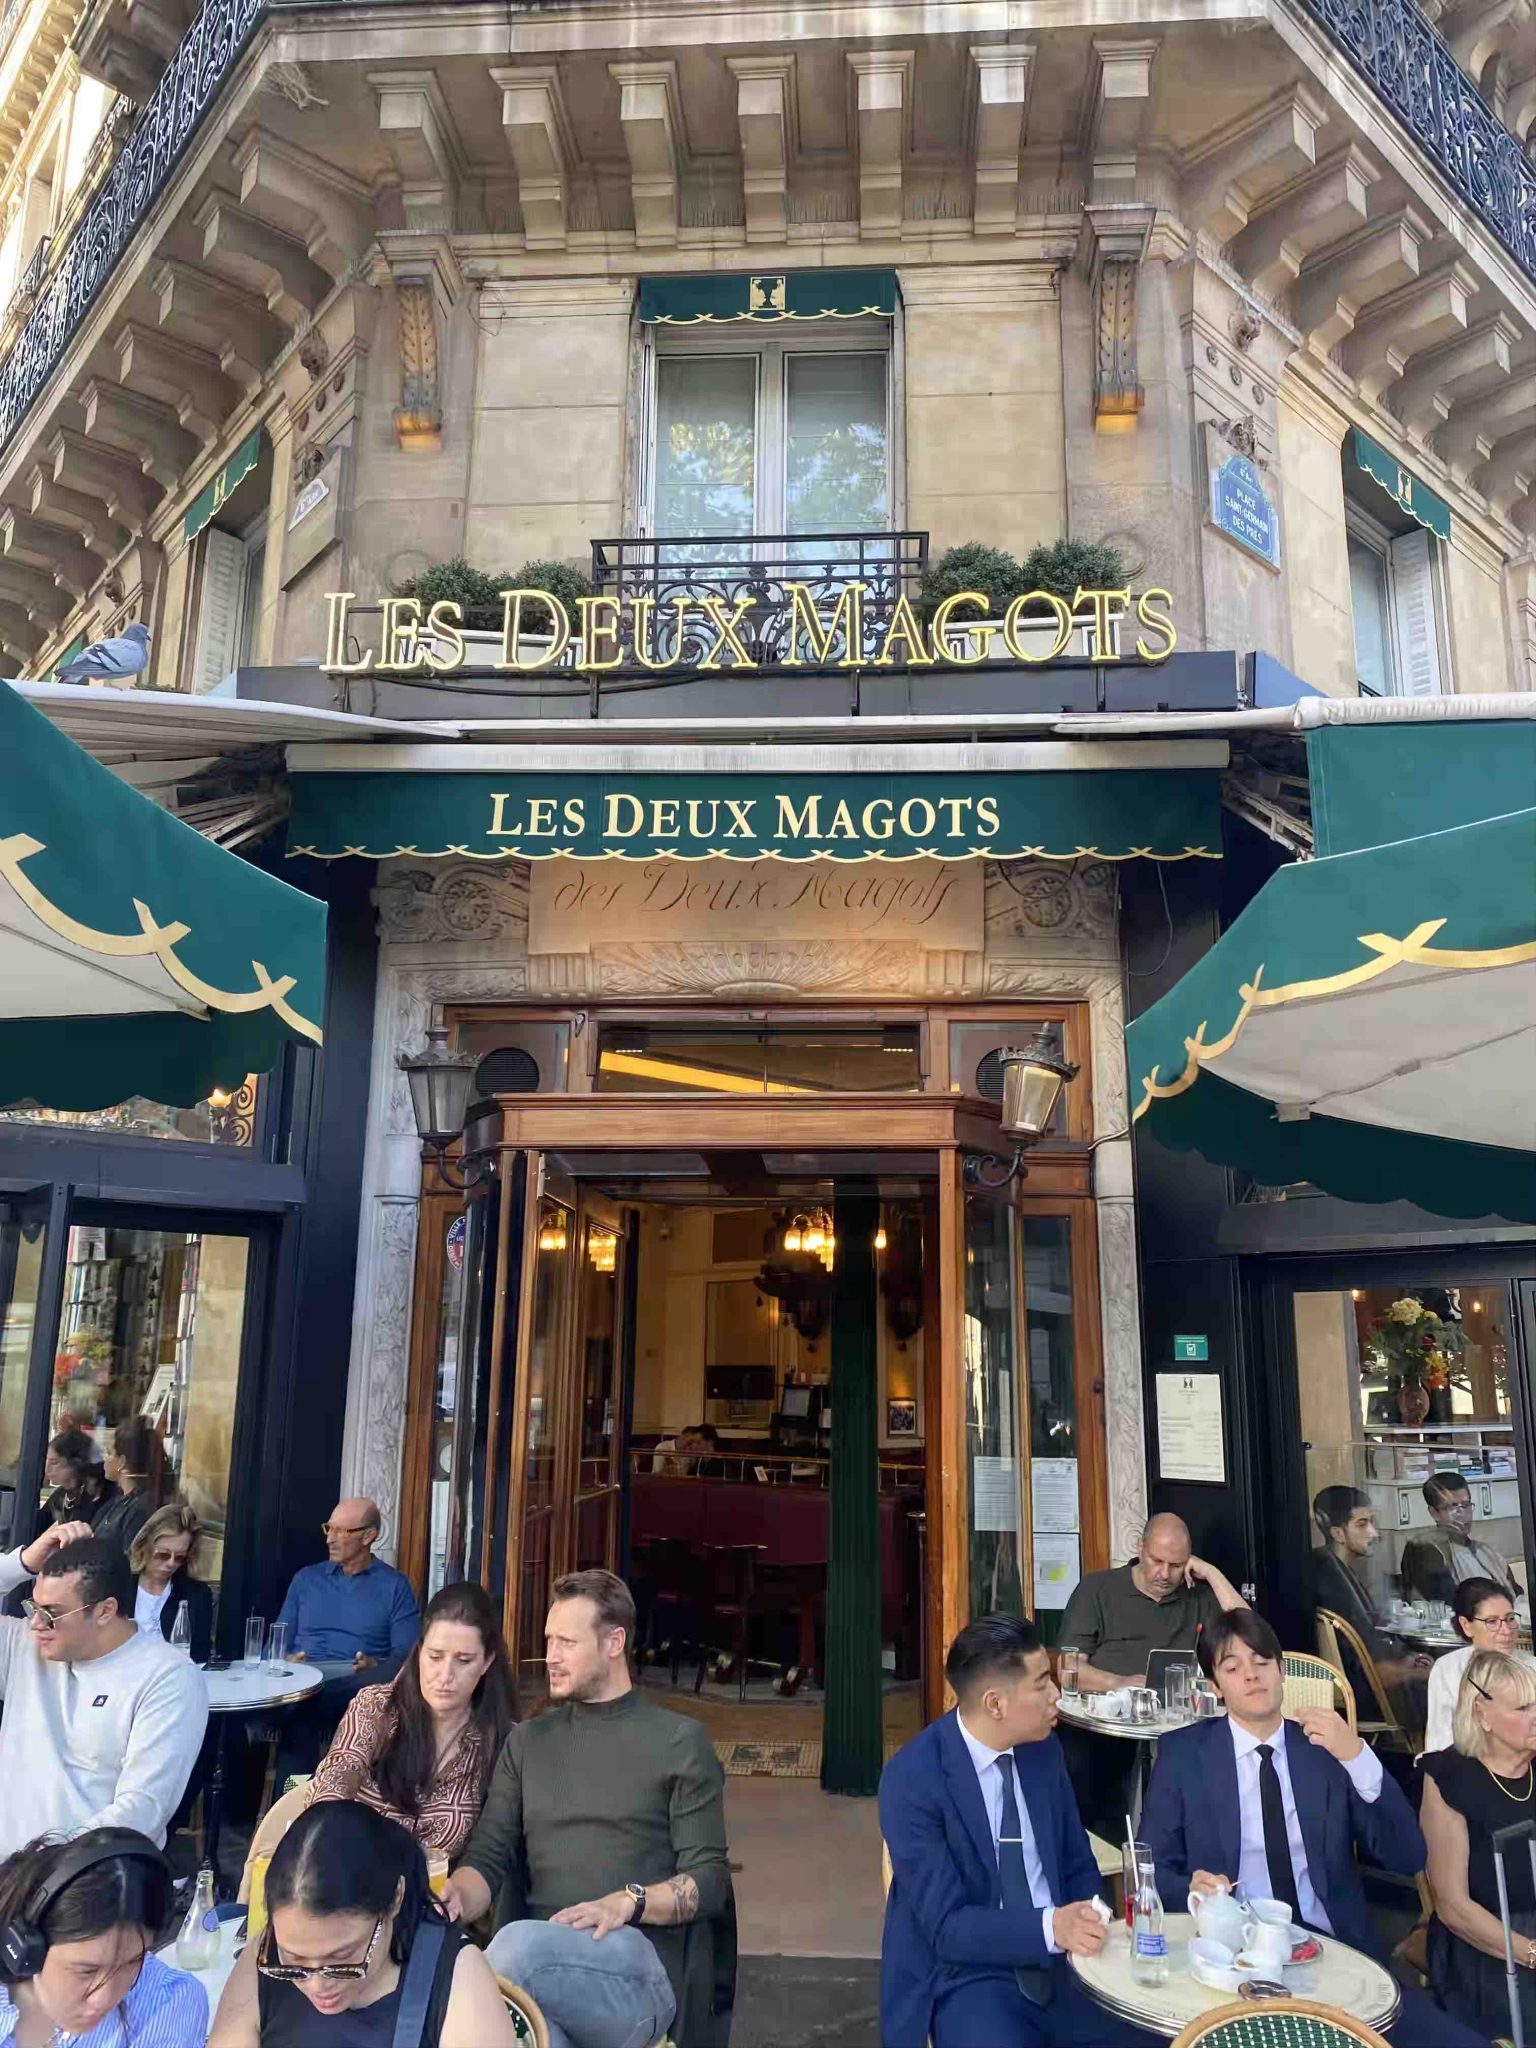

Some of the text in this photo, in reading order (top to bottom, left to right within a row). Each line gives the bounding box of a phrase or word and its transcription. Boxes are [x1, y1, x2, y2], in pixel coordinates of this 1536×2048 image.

[1225, 495, 1269, 534] SAINT-GERMAIN
[1237, 488, 1256, 511] PLACE
[1232, 515, 1245, 532] DES
[319, 585, 1178, 671] LES DEUX MAGOTS
[486, 793, 1001, 839] LES DEUX MAGOTS
